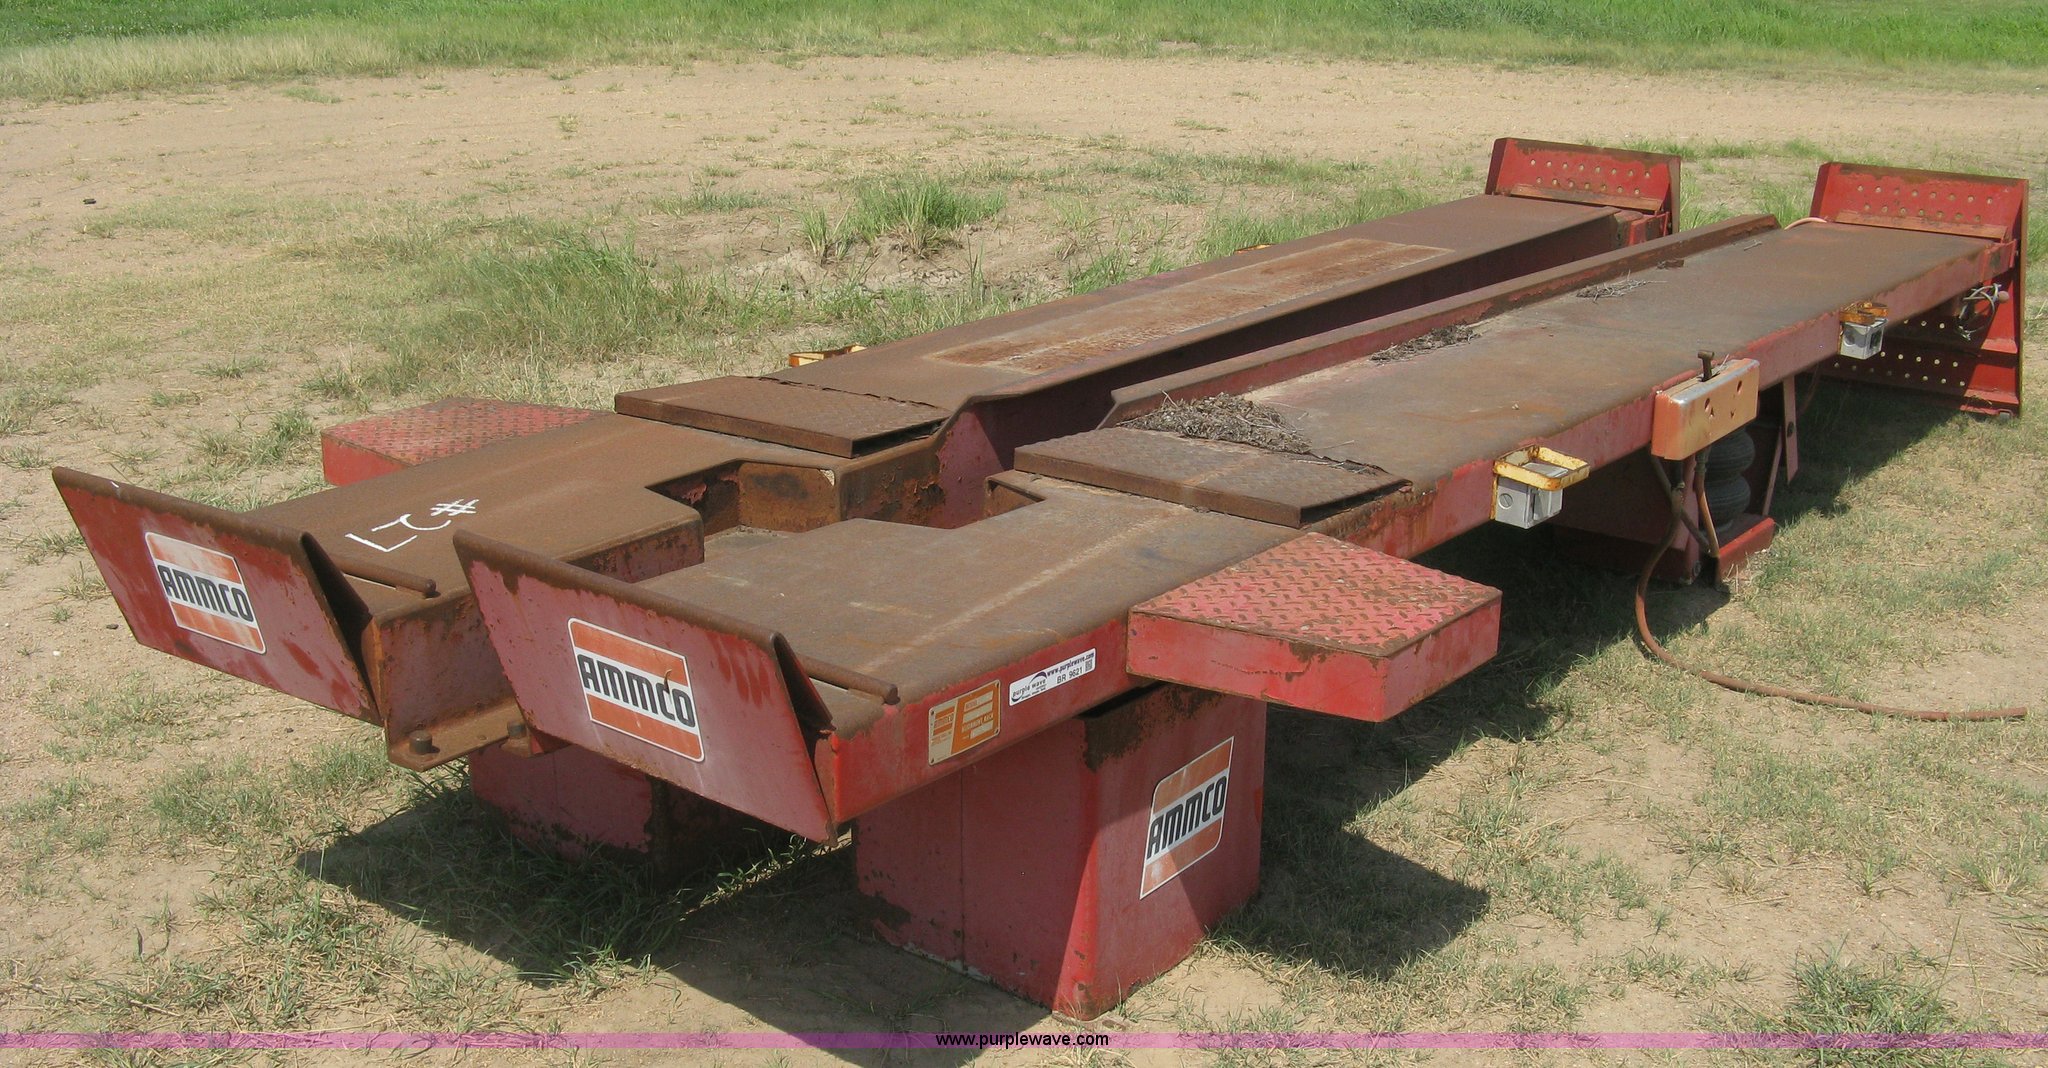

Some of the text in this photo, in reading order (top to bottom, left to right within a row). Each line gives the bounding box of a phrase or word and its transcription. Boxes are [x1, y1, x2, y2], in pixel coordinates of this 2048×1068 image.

[156, 563, 255, 624] AMMCO
[577, 653, 696, 728] AMMCO
[1012, 682, 1031, 697] purple
[1031, 679, 1046, 689] wave
[1146, 775, 1228, 860] AMMCO
